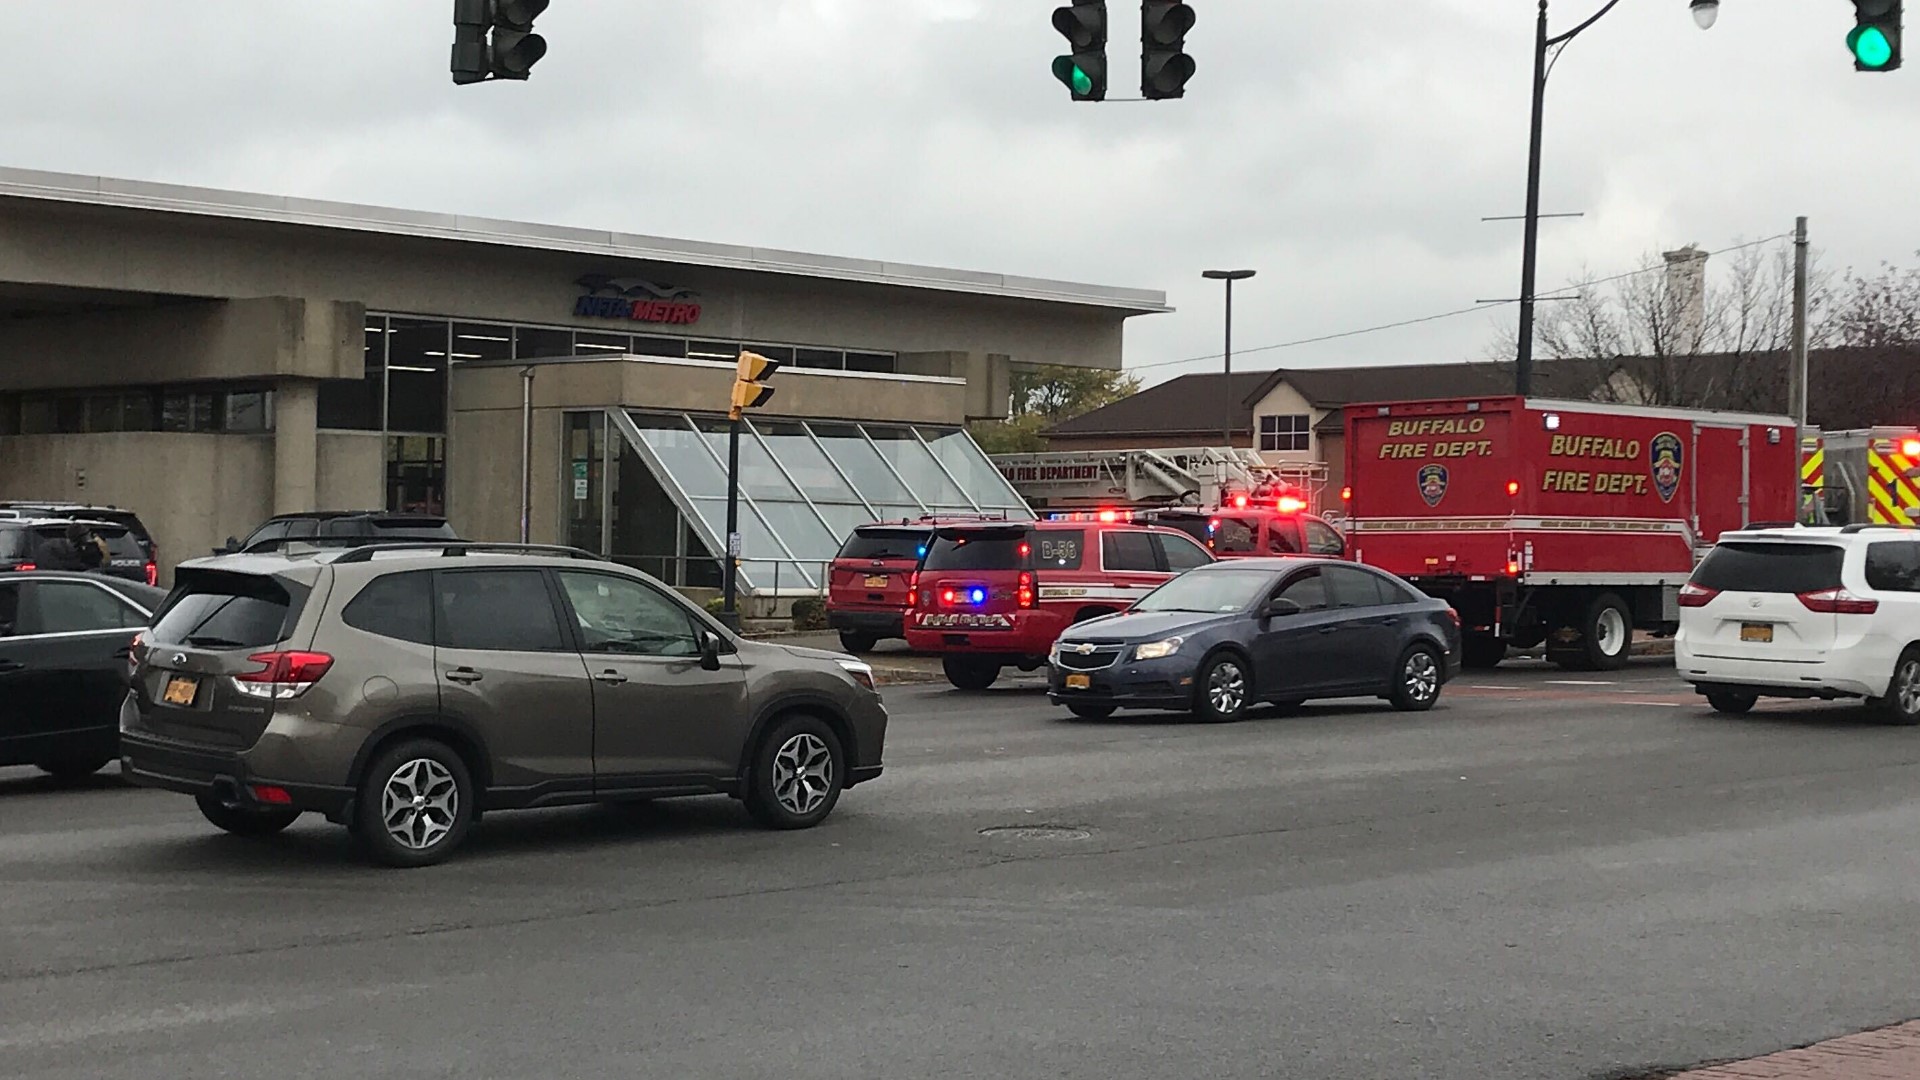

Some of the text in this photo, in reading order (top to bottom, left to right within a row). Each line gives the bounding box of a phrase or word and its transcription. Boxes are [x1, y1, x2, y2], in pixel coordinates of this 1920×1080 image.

[1388, 418, 1485, 437] BUFFALO
[1379, 440, 1492, 459] FIRE DEPT.
[1550, 434, 1640, 459] BUFFALO
[1017, 467, 1037, 480] FIRE
[1040, 465, 1098, 480] DEPARTMENT
[1542, 470, 1648, 494] FIRE DEPT.
